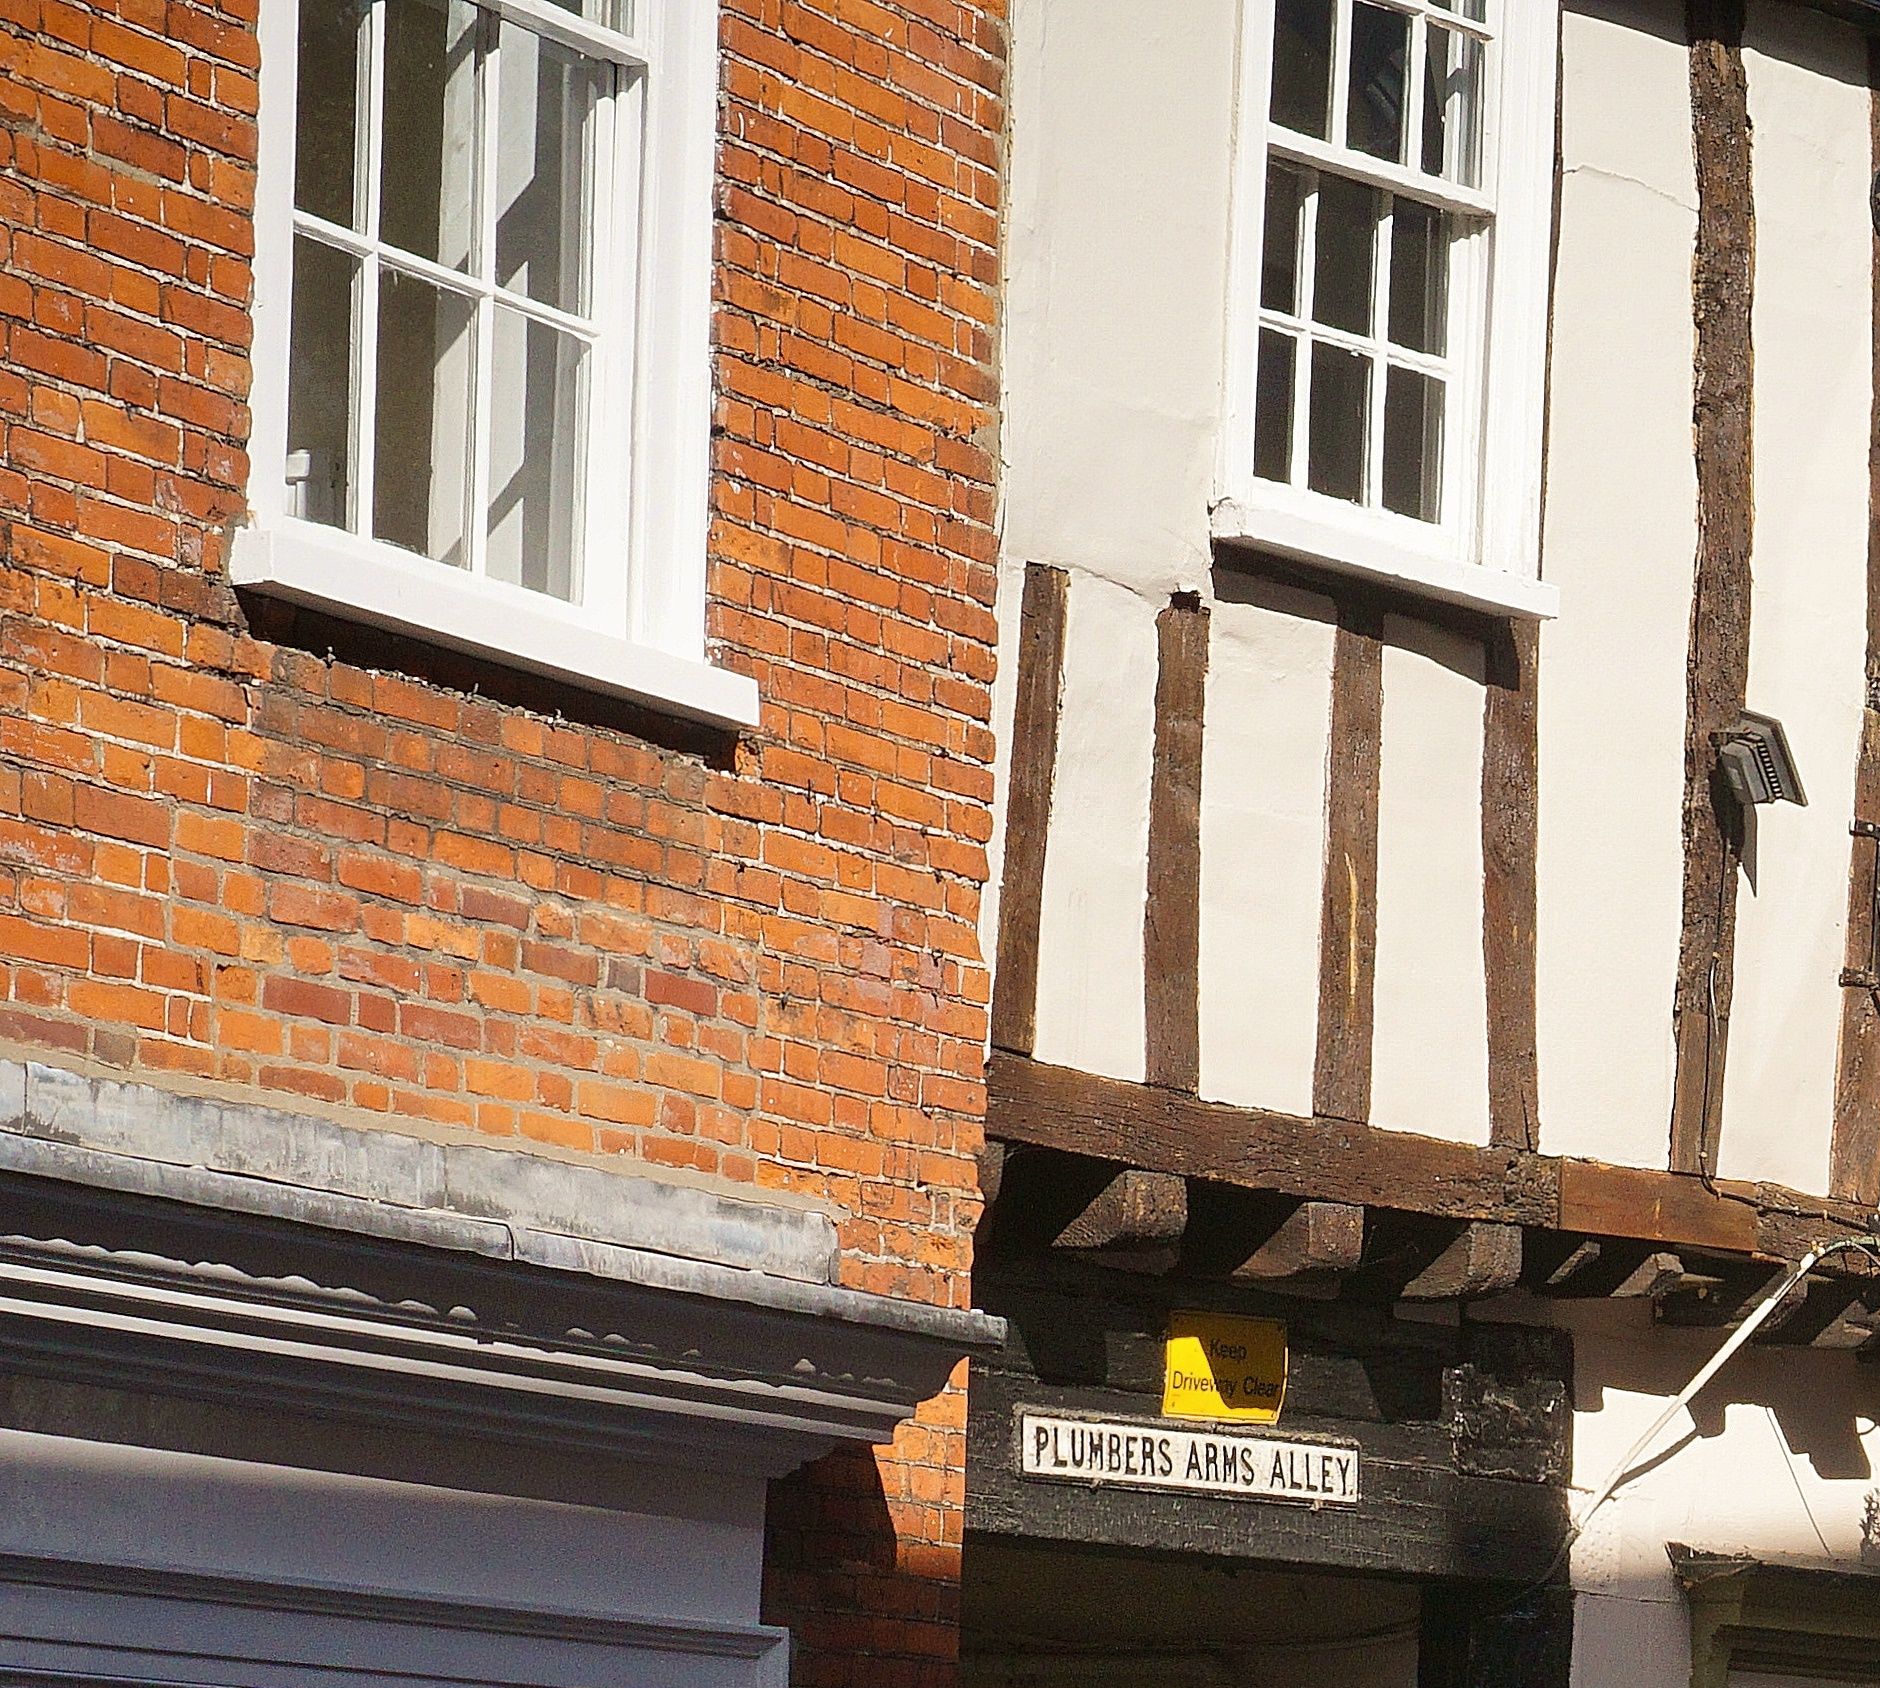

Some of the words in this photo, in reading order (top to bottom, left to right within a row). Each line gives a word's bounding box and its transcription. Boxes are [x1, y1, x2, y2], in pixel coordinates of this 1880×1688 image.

[1208, 1339, 1248, 1361] Keep
[1172, 1370, 1237, 1398] Driveway
[1243, 1375, 1281, 1398] Clear
[1035, 1426, 1173, 1477] PLUMBERS
[1186, 1441, 1255, 1485] ARMS
